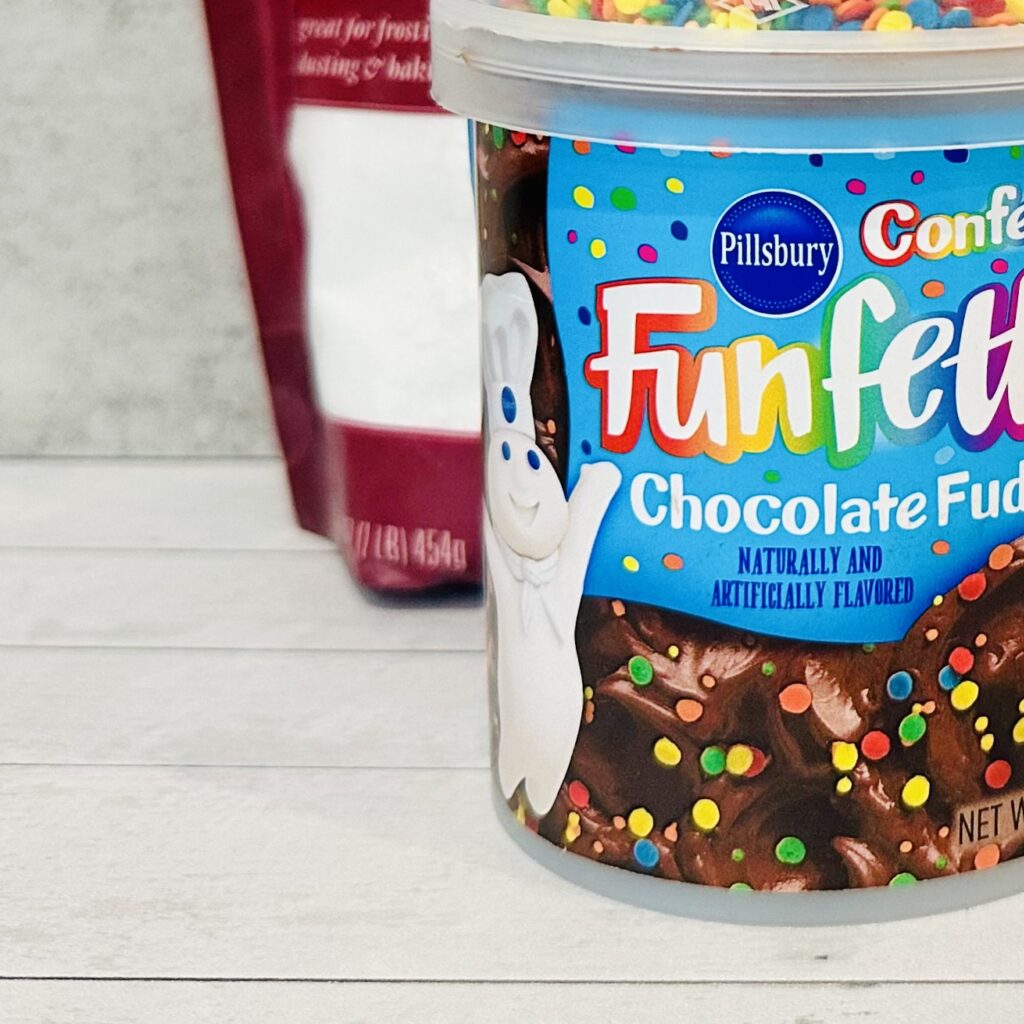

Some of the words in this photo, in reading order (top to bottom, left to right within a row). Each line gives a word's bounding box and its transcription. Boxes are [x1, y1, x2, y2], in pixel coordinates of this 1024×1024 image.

[297, 17, 343, 42] great
[338, 13, 377, 47] for
[363, 55, 385, 80] &
[720, 231, 834, 276] Pillsbury
[630, 471, 926, 536] Chocolate
[736, 545, 842, 576] NATURALLY
[846, 545, 883, 574] AND
[710, 579, 826, 609] ARTIFICIALLY
[832, 576, 914, 609] FLAVORED
[958, 804, 1004, 844] NET
